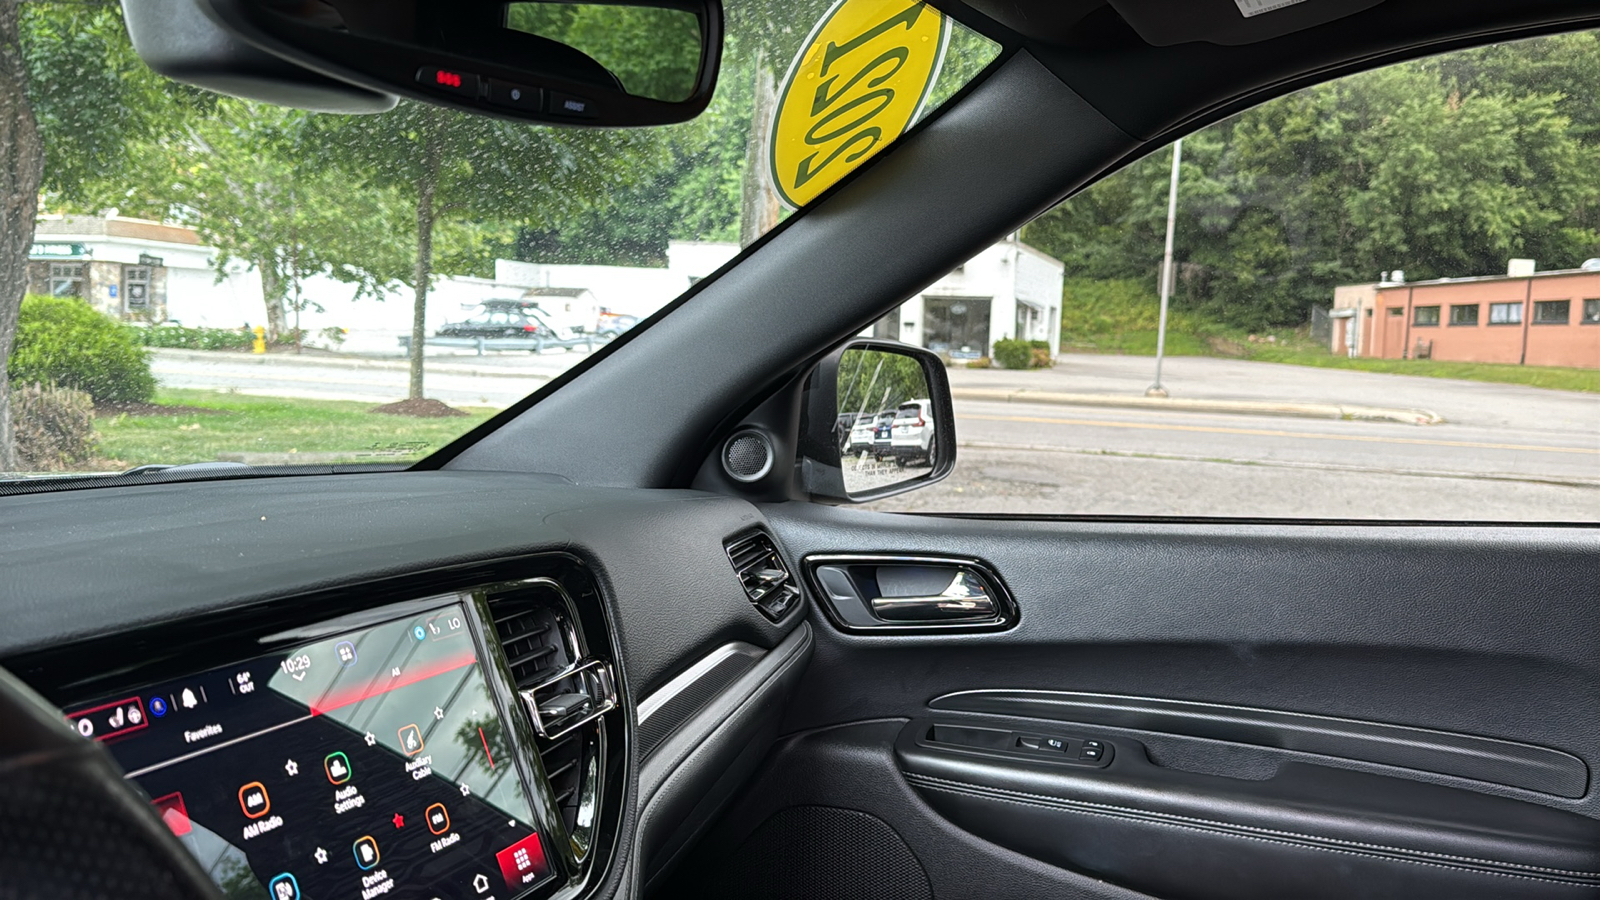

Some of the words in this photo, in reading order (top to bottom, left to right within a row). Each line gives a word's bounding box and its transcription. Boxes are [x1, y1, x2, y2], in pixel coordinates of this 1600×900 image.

[280, 655, 311, 674] 10:29
[184, 722, 223, 743] Favorites
[405, 755, 432, 772] Auxiliary
[412, 766, 432, 780] Cable
[335, 785, 357, 801] Audio
[334, 795, 365, 814] Settings
[243, 823, 259, 840] AM
[258, 815, 283, 834] Radio
[431, 812, 444, 825] FM
[430, 841, 443, 853] FM
[442, 833, 461, 848] Radio
[361, 869, 388, 888] Device
[522, 872, 535, 883] Apps
[361, 878, 394, 900] Manager
